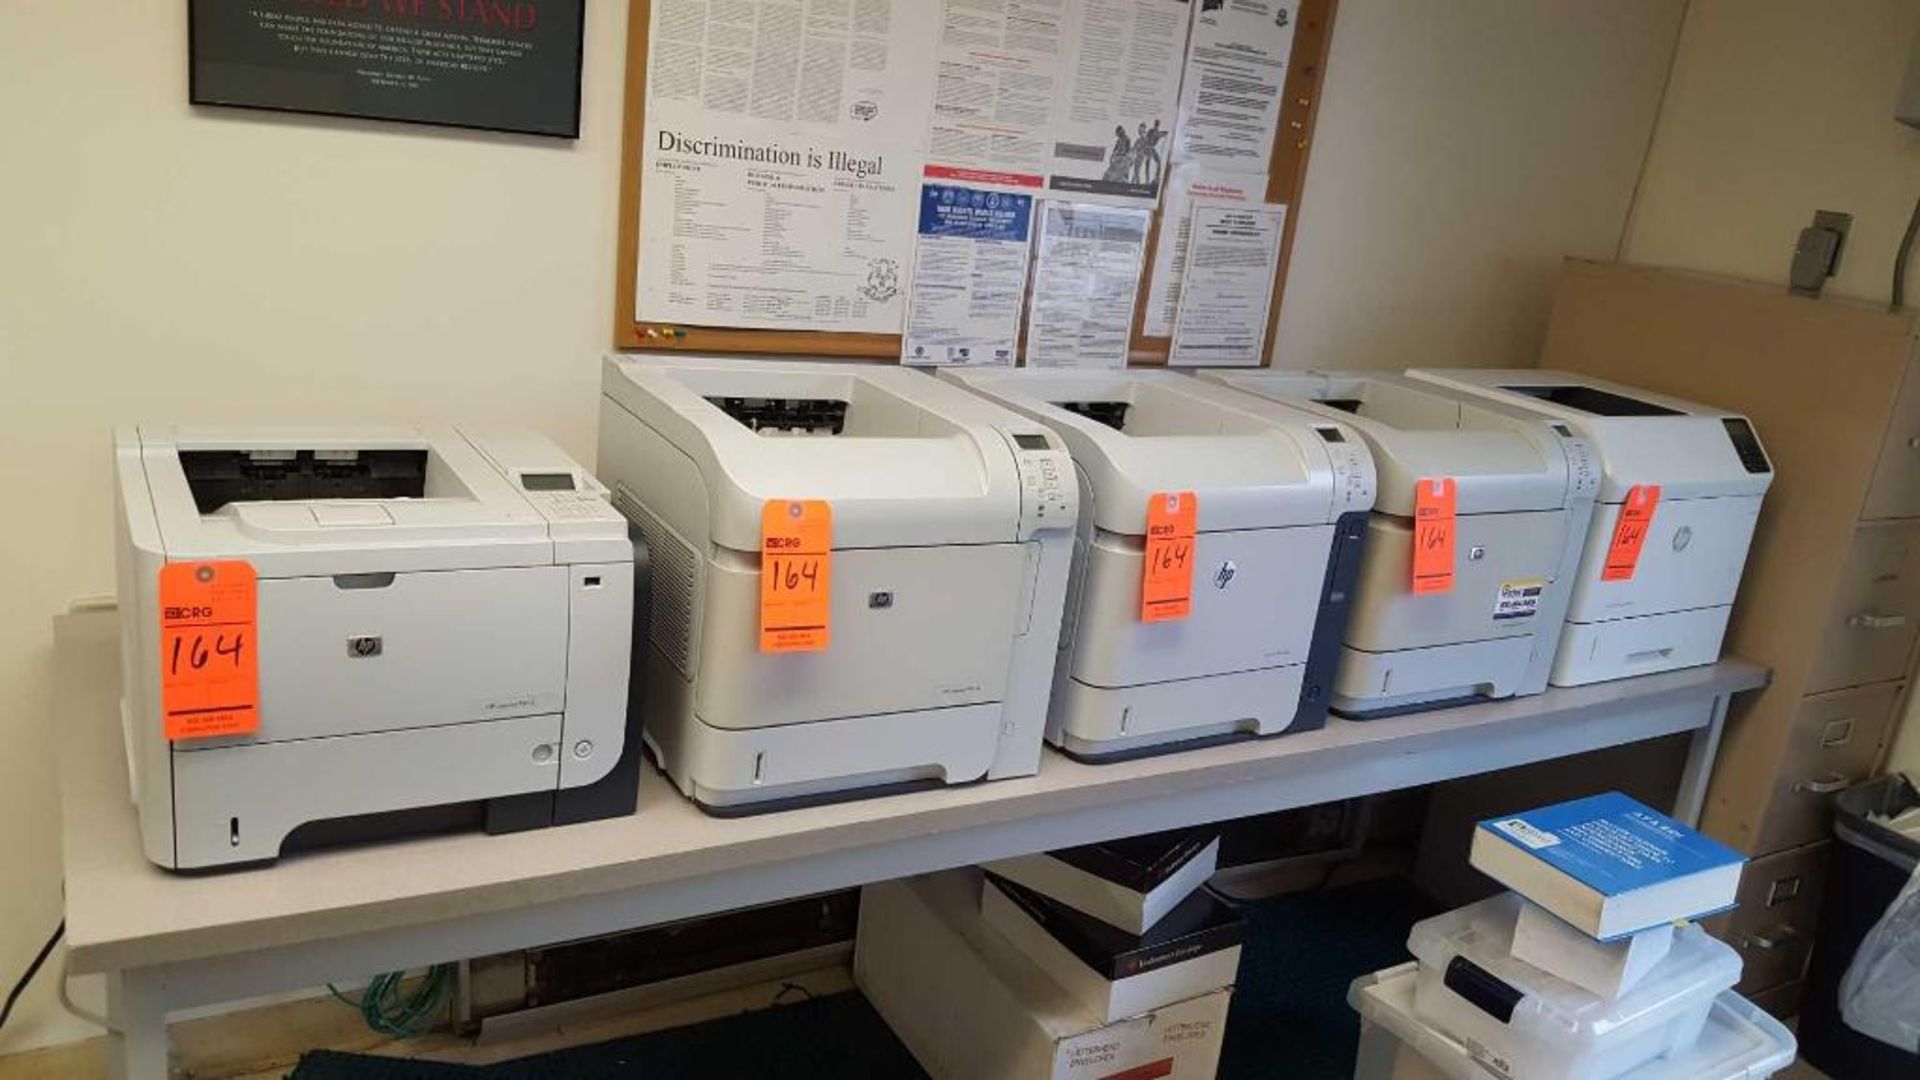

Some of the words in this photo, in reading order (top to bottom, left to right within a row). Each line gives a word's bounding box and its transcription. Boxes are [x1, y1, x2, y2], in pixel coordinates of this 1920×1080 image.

[436, 0, 537, 32] STAND
[657, 130, 800, 167] Discrimination
[807, 147, 823, 170] is
[828, 150, 883, 179] Illegal
[1420, 526, 1447, 550] 164
[1615, 524, 1643, 548] 164
[772, 560, 818, 592] 164
[1151, 544, 1188, 577] 164
[1216, 561, 1235, 590] hp
[171, 633, 243, 675] 164
